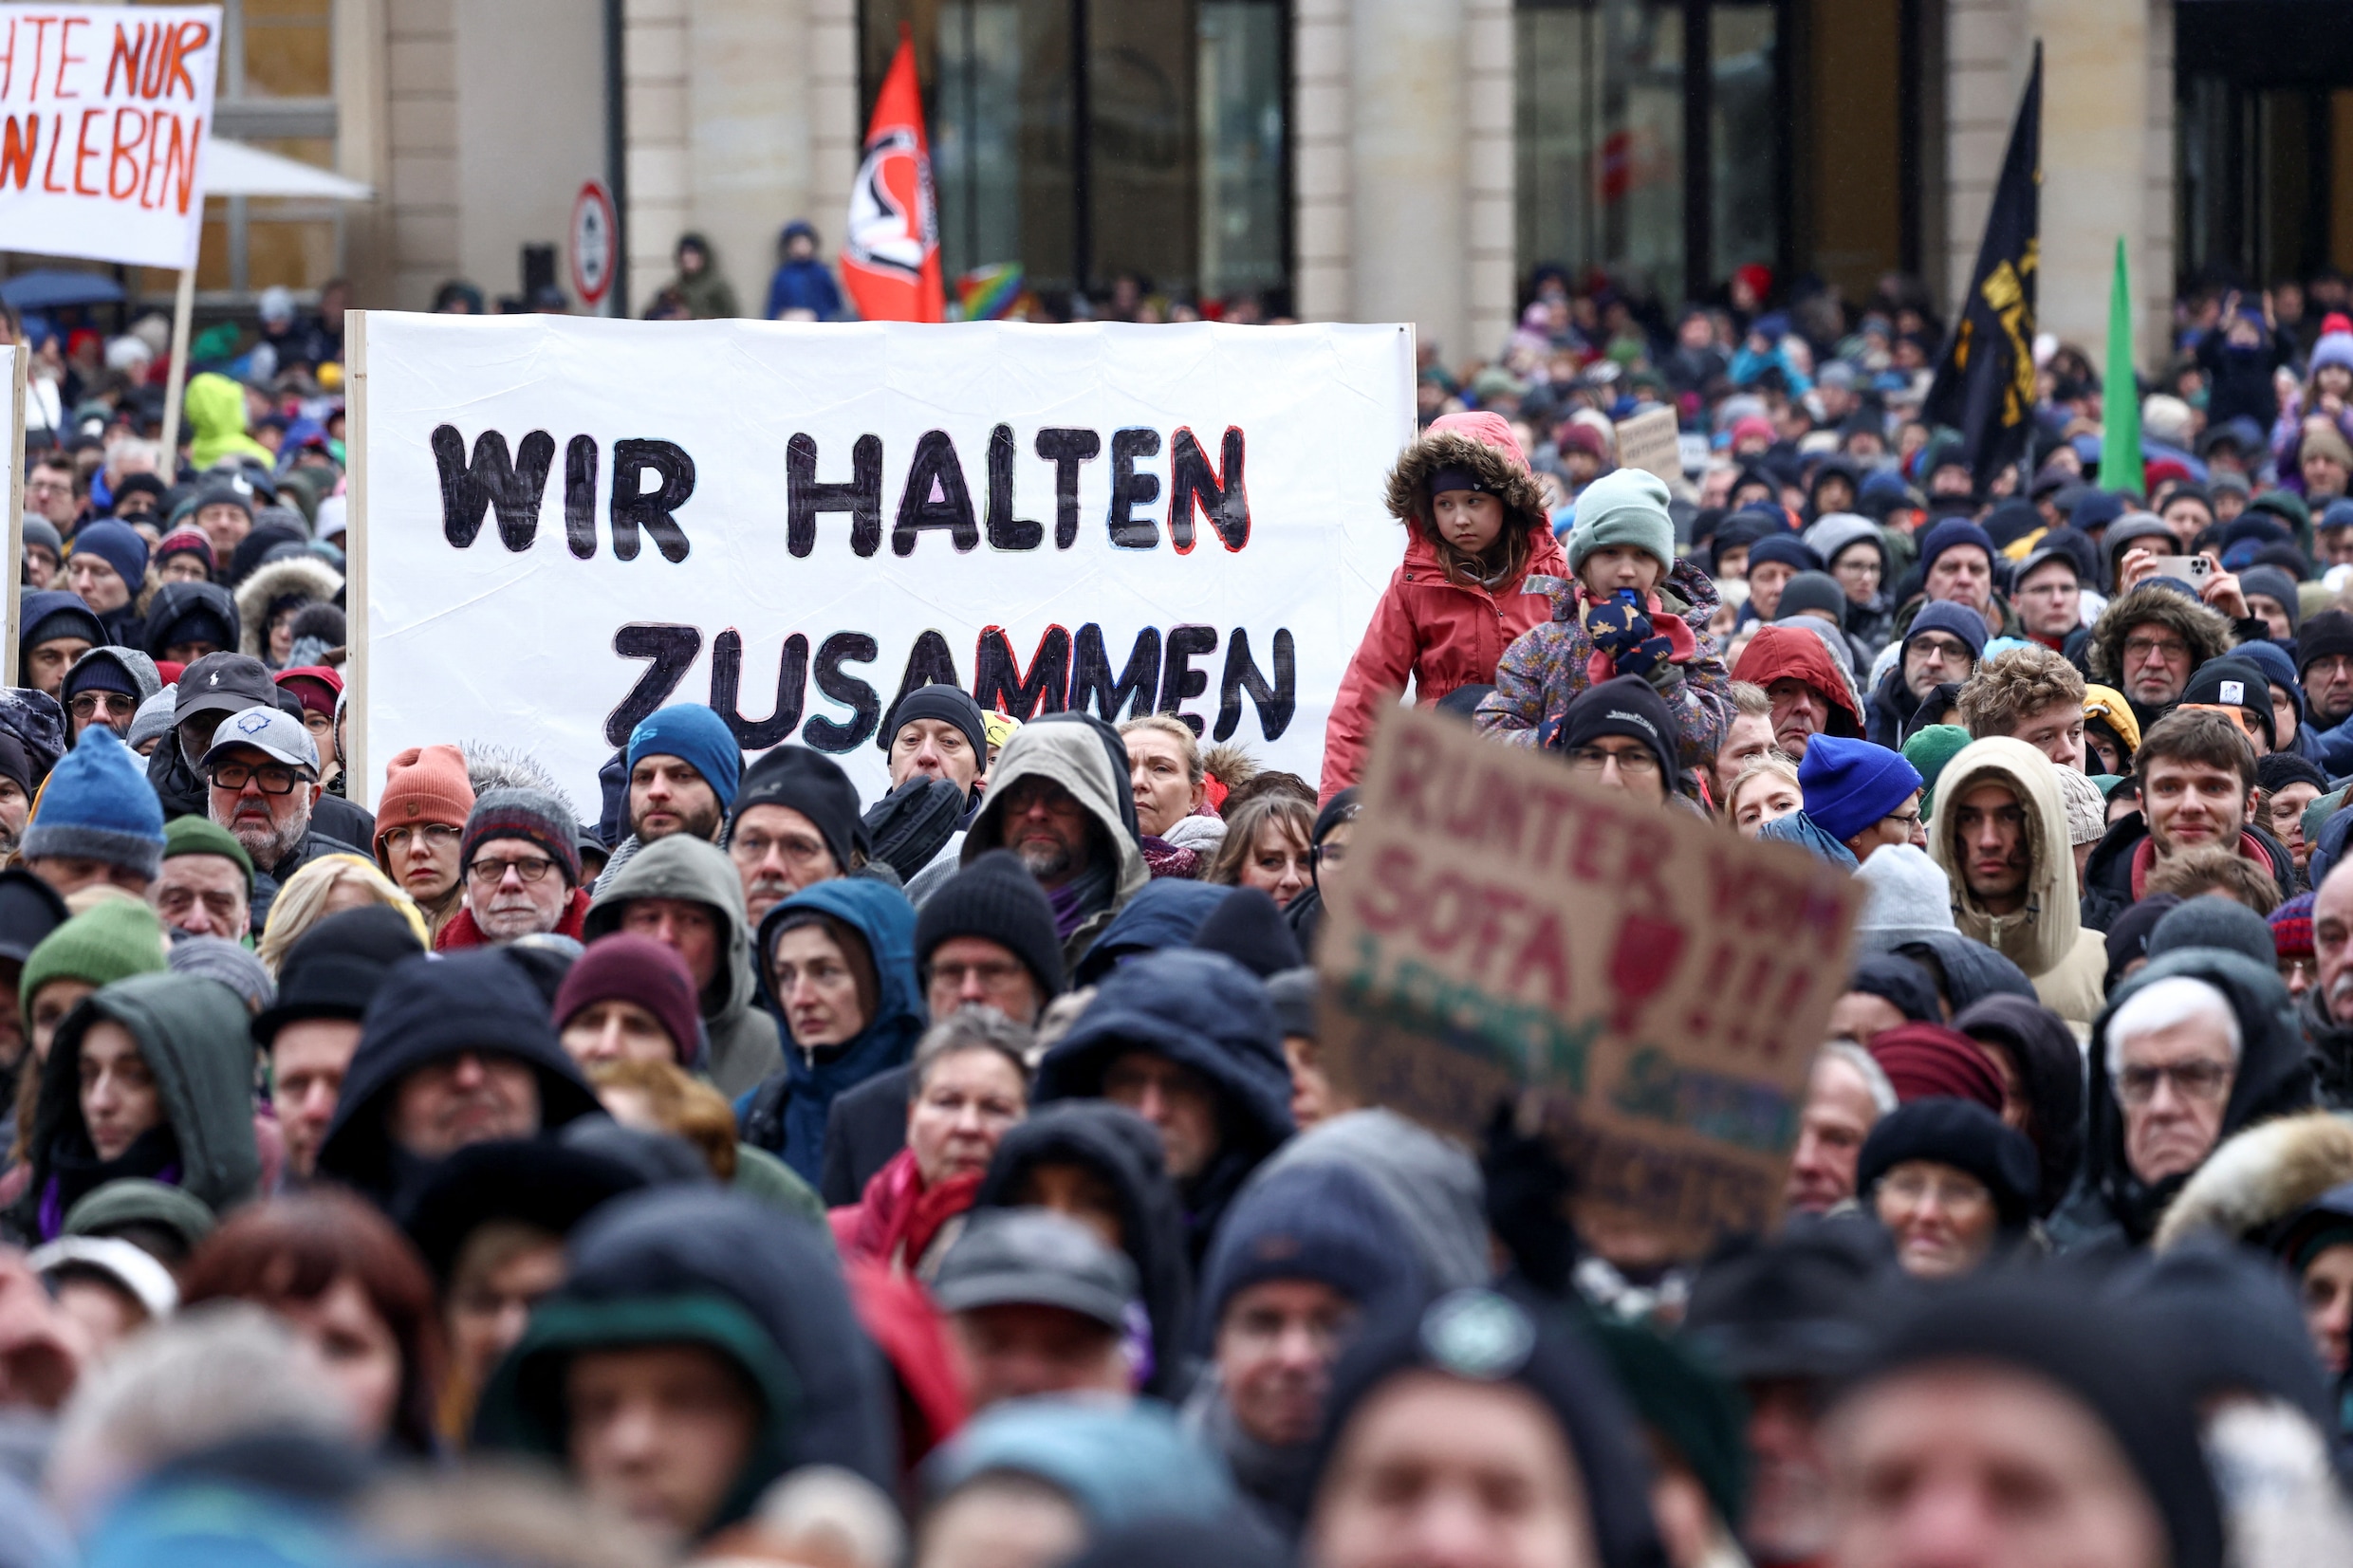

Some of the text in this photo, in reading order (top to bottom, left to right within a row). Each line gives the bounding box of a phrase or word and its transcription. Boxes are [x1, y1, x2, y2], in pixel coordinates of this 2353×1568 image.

[103, 20, 210, 101] NUR
[44, 106, 202, 216] LEBEN
[430, 422, 1251, 564] WIR HALTEN
[603, 622, 1297, 753] ZUSAMMEN
[1389, 723, 1674, 913] RUNTER
[1352, 844, 1572, 1011] SOFA
